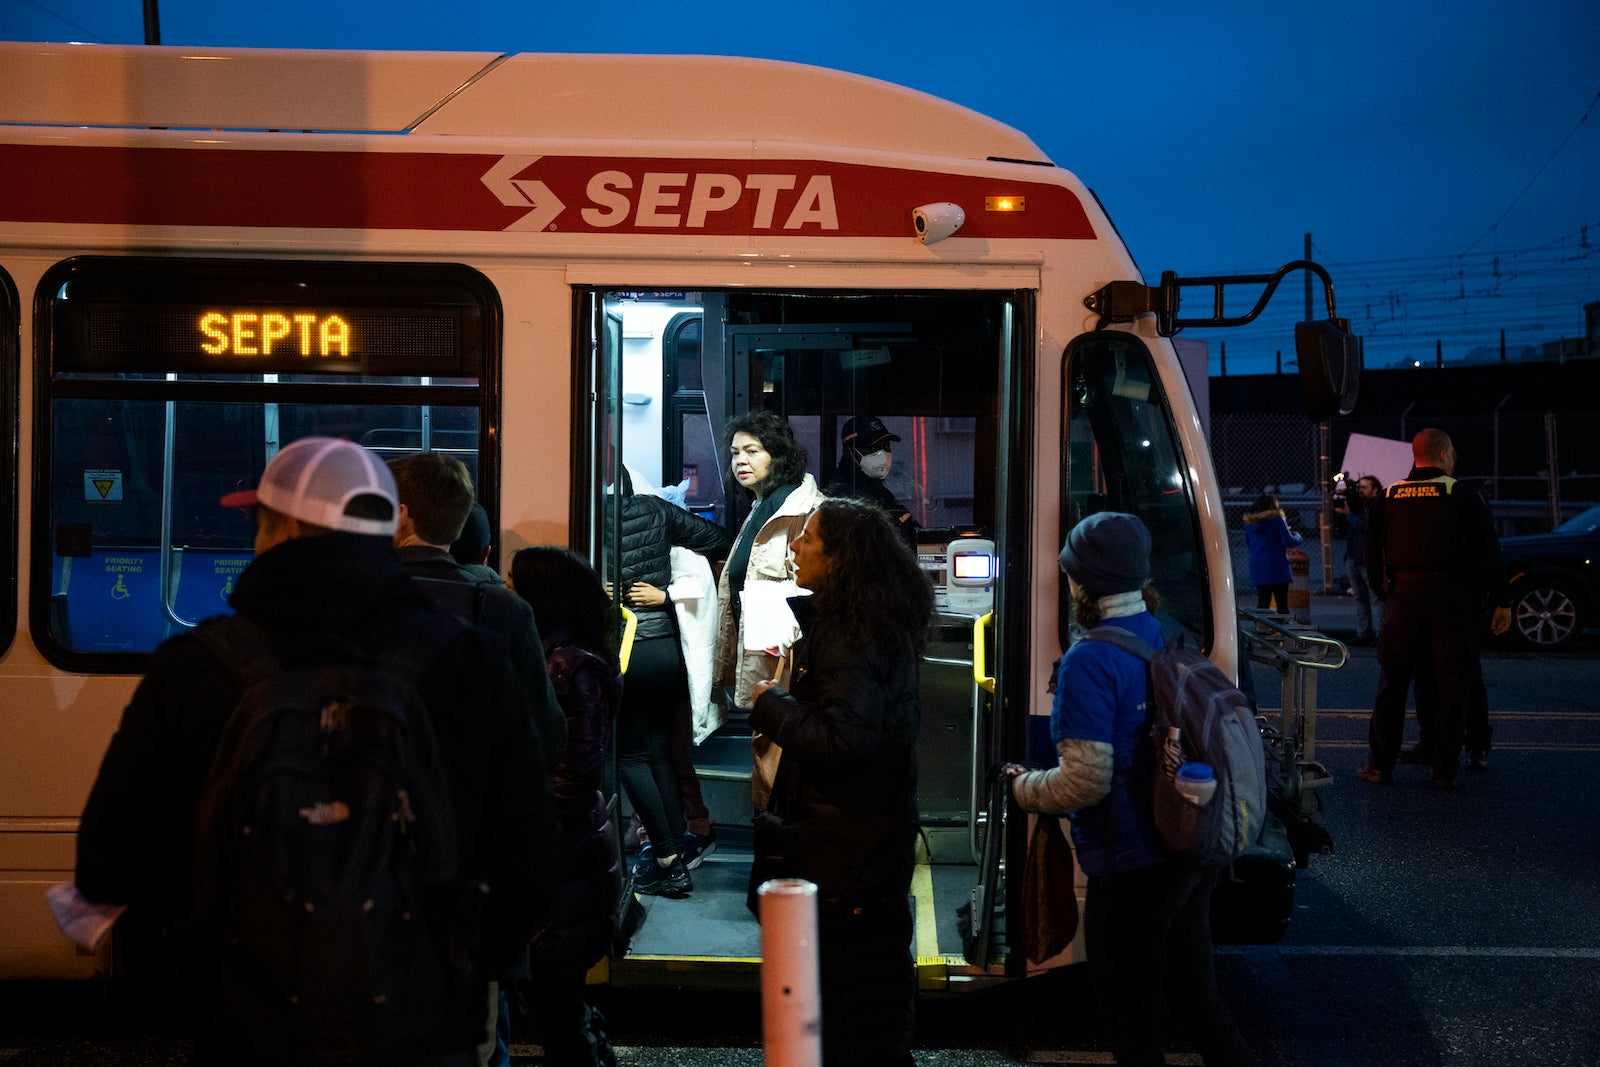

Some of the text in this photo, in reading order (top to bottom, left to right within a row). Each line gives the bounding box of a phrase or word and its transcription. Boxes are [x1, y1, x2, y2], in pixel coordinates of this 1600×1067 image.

[580, 169, 840, 230] SEPTA
[200, 313, 349, 356] SEPTA
[1397, 485, 1437, 494] POLICE
[104, 557, 144, 565] PRIORITY
[105, 565, 143, 573] SEATING
